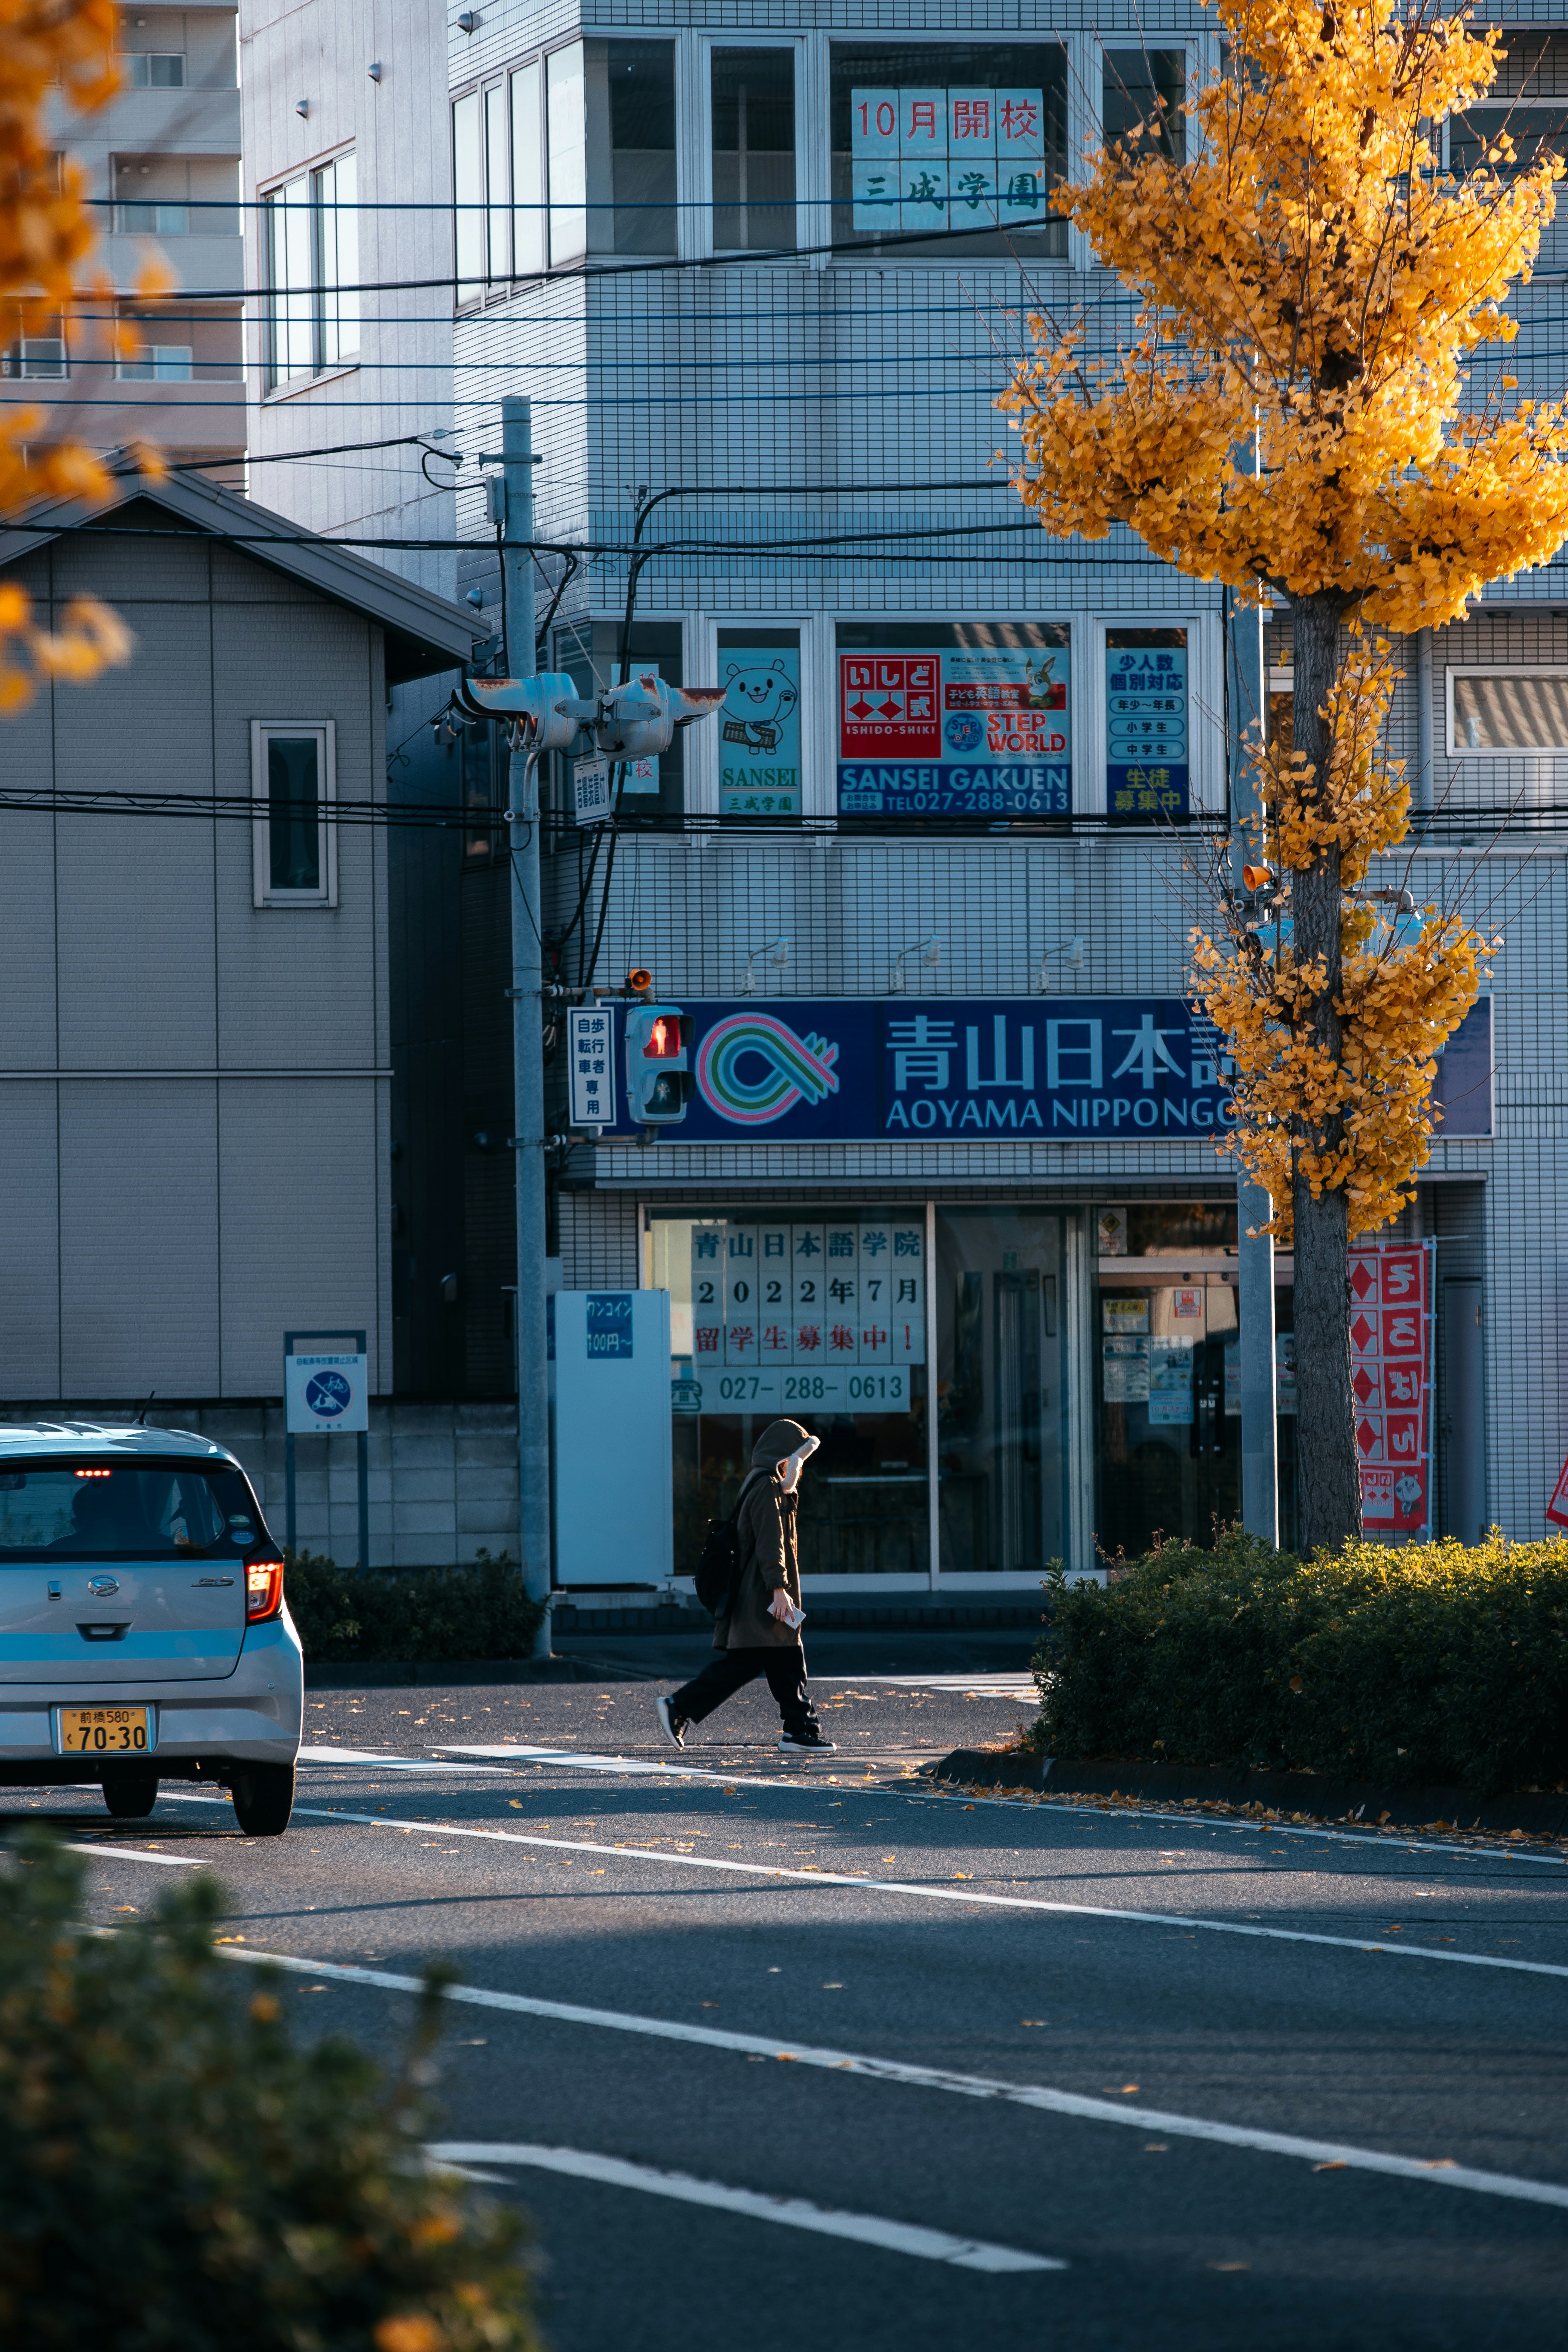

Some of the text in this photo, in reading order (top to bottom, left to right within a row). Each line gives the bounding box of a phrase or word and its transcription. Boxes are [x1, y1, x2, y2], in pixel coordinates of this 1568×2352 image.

[858, 99, 1039, 139] 10月開校
[861, 172, 1038, 210] 三成学園
[1119, 654, 1174, 671] 少人数
[850, 665, 929, 686] いしど
[1110, 673, 1183, 691] 個別対応
[910, 696, 930, 717] 式
[847, 726, 935, 734] ISHIDO-SHIKI
[951, 719, 977, 734] STEP
[987, 713, 1046, 732] STEP
[1127, 722, 1167, 733] 小学生
[948, 734, 980, 743] WORLD
[987, 733, 1066, 752] WORLD
[1127, 744, 1167, 755] 中学生
[723, 768, 798, 787] SANSEI
[842, 768, 1068, 791] SANSEI GAKUEN
[1126, 768, 1170, 789] 生徒
[729, 796, 792, 812] 三成学園
[1115, 790, 1181, 811] 募集中
[577, 1019, 591, 1074] 自転車
[591, 1018, 605, 1074] 歩行者
[586, 1080, 600, 1115] 専用
[886, 1099, 1044, 1128] AOYAMA
[695, 1231, 921, 1259] 青山日本語学院
[699, 1278, 917, 1304] 2022年7月
[587, 1302, 632, 1317] ワンコイン
[67, 1733, 72, 1744] く
[78, 1726, 146, 1750] 70-30
